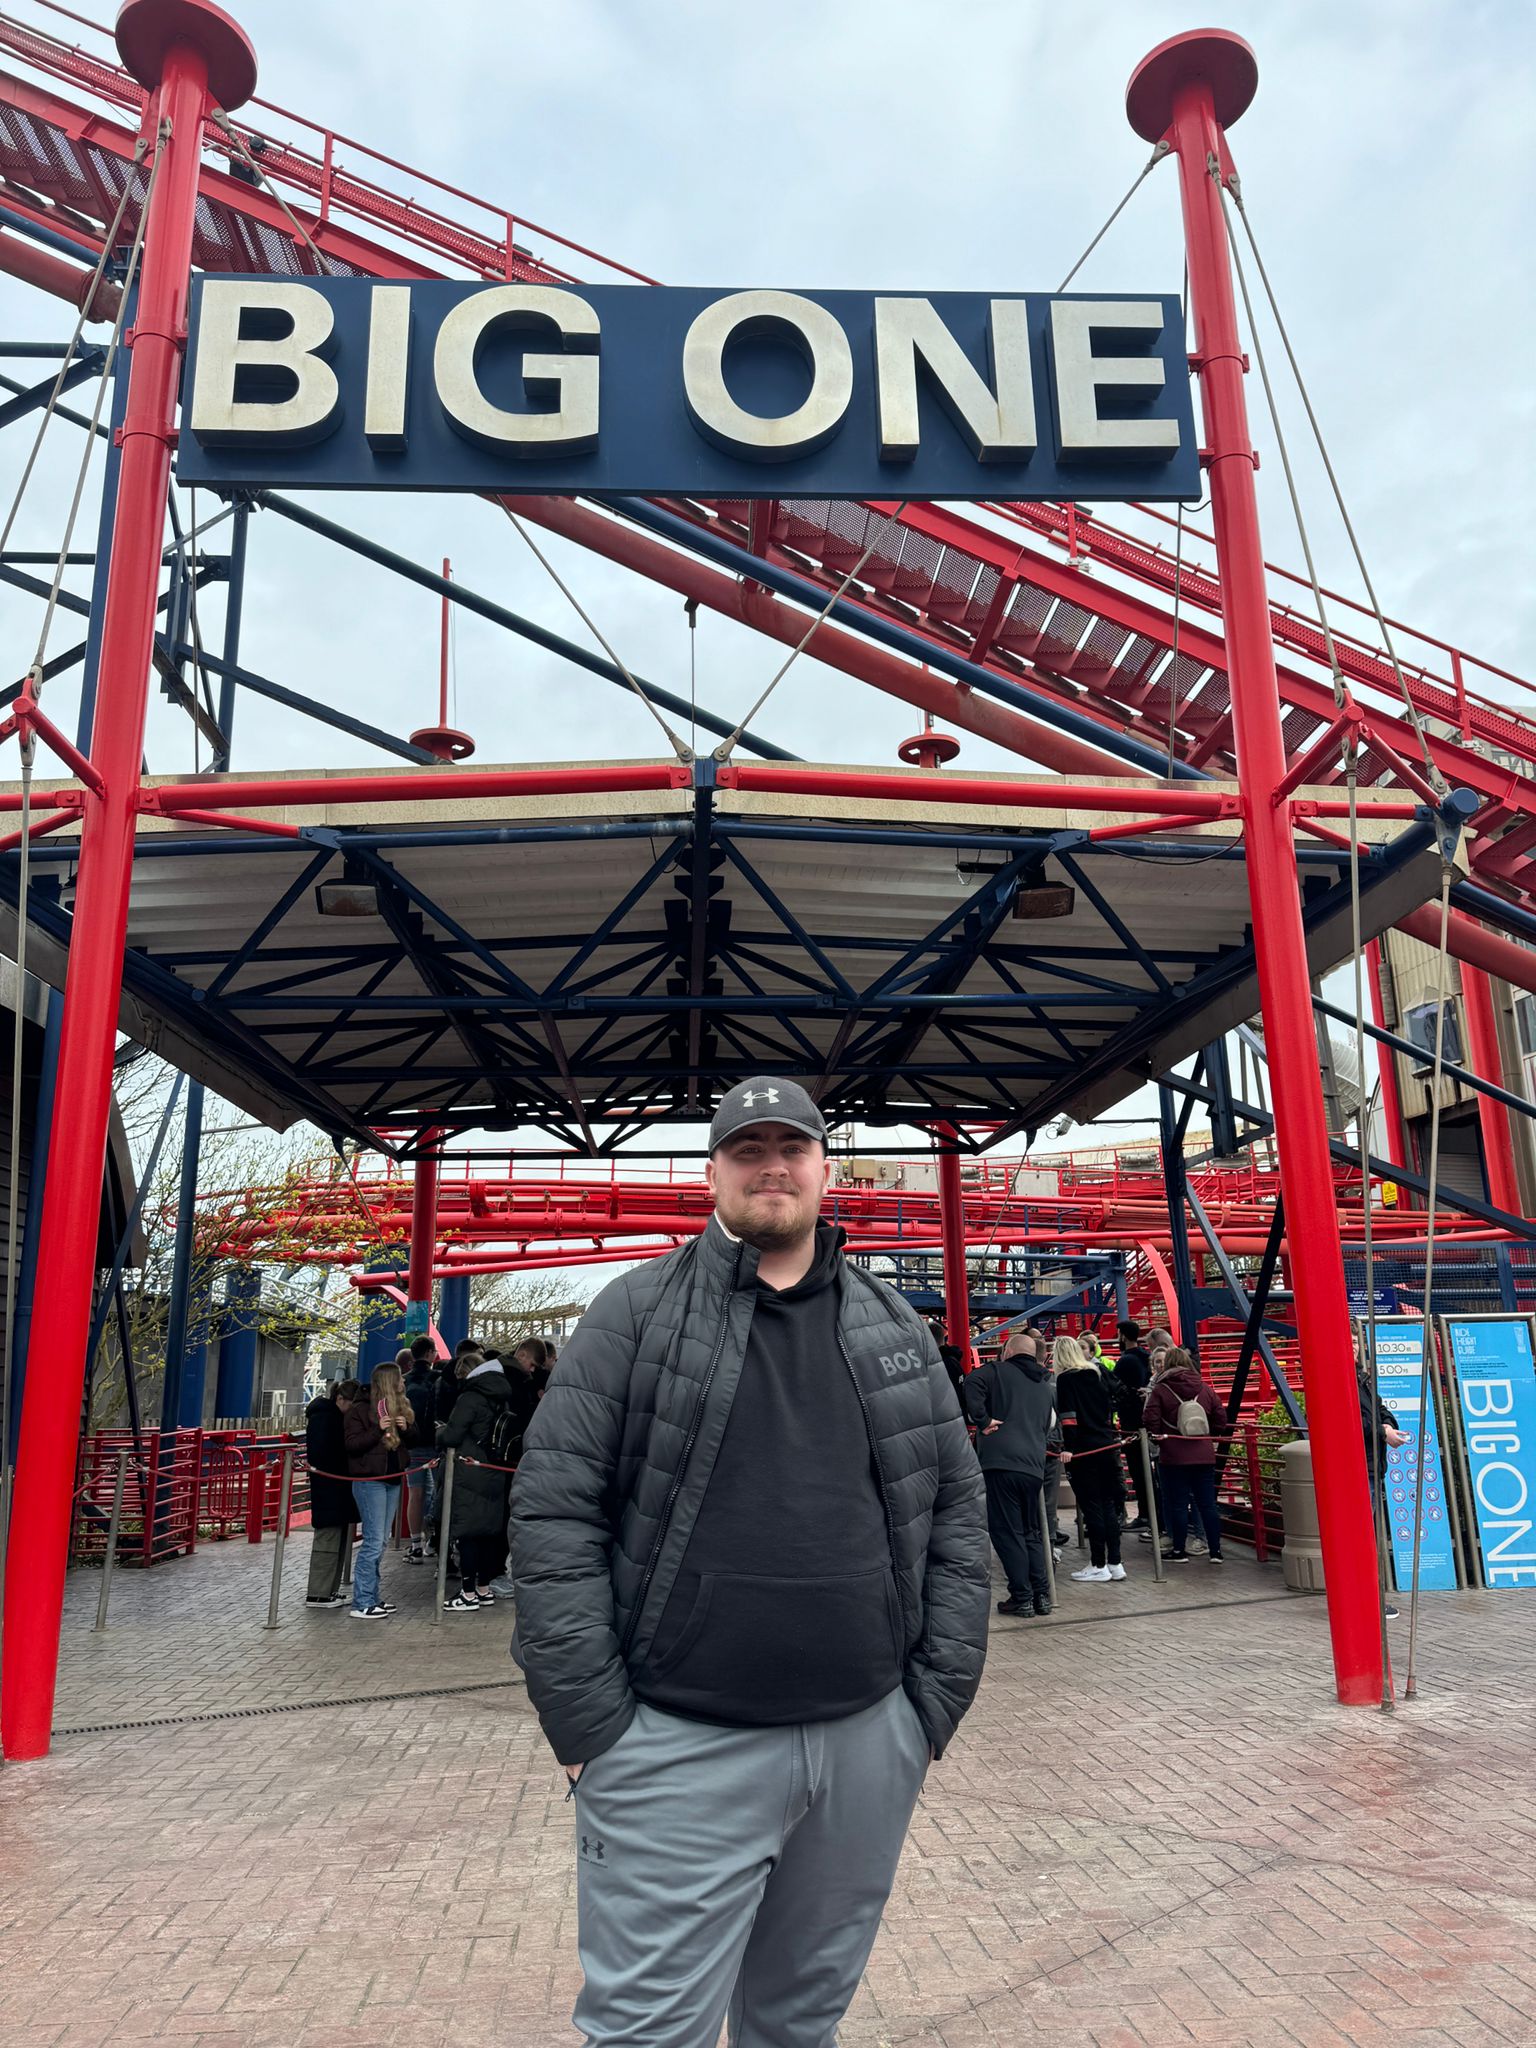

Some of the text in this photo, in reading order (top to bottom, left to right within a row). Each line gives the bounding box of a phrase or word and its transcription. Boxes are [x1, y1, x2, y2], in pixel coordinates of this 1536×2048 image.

[191, 280, 1181, 448] BIG ONE
[1462, 1379, 1521, 1455] BIG
[1476, 1461, 1536, 1584] ONE
